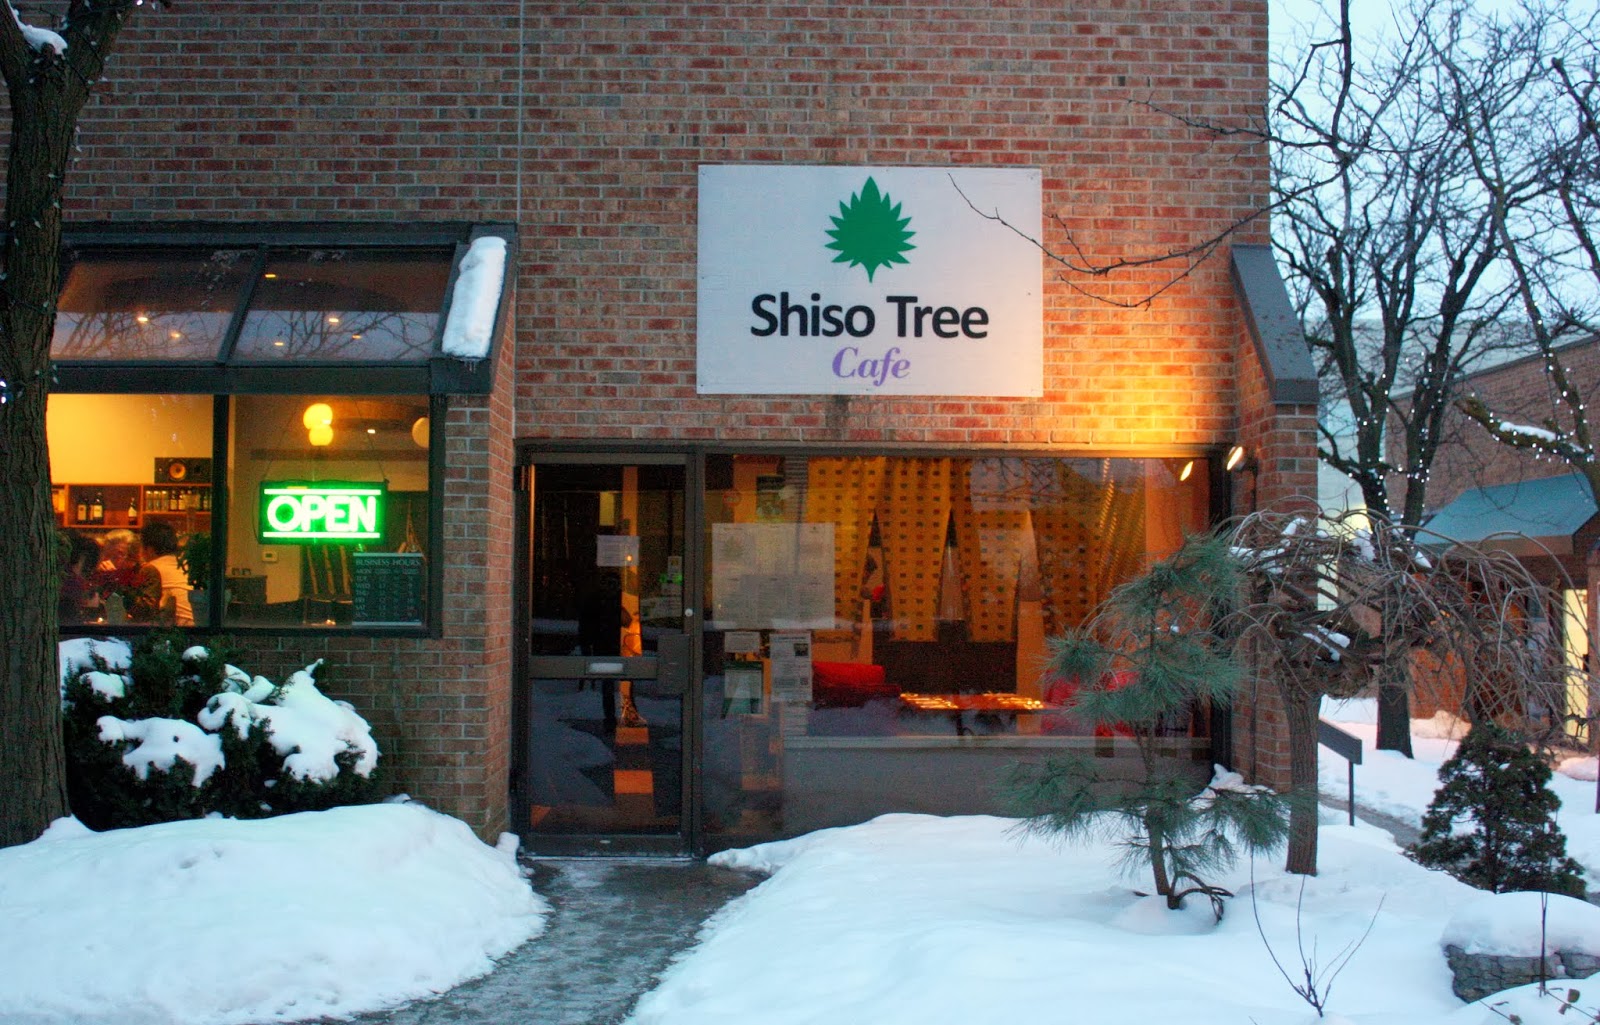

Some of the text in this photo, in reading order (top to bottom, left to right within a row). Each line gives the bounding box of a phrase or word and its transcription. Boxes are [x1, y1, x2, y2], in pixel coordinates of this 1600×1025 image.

[750, 291, 990, 339] Shiso Tree
[832, 347, 911, 387] Cafe
[266, 495, 377, 532] OPEN
